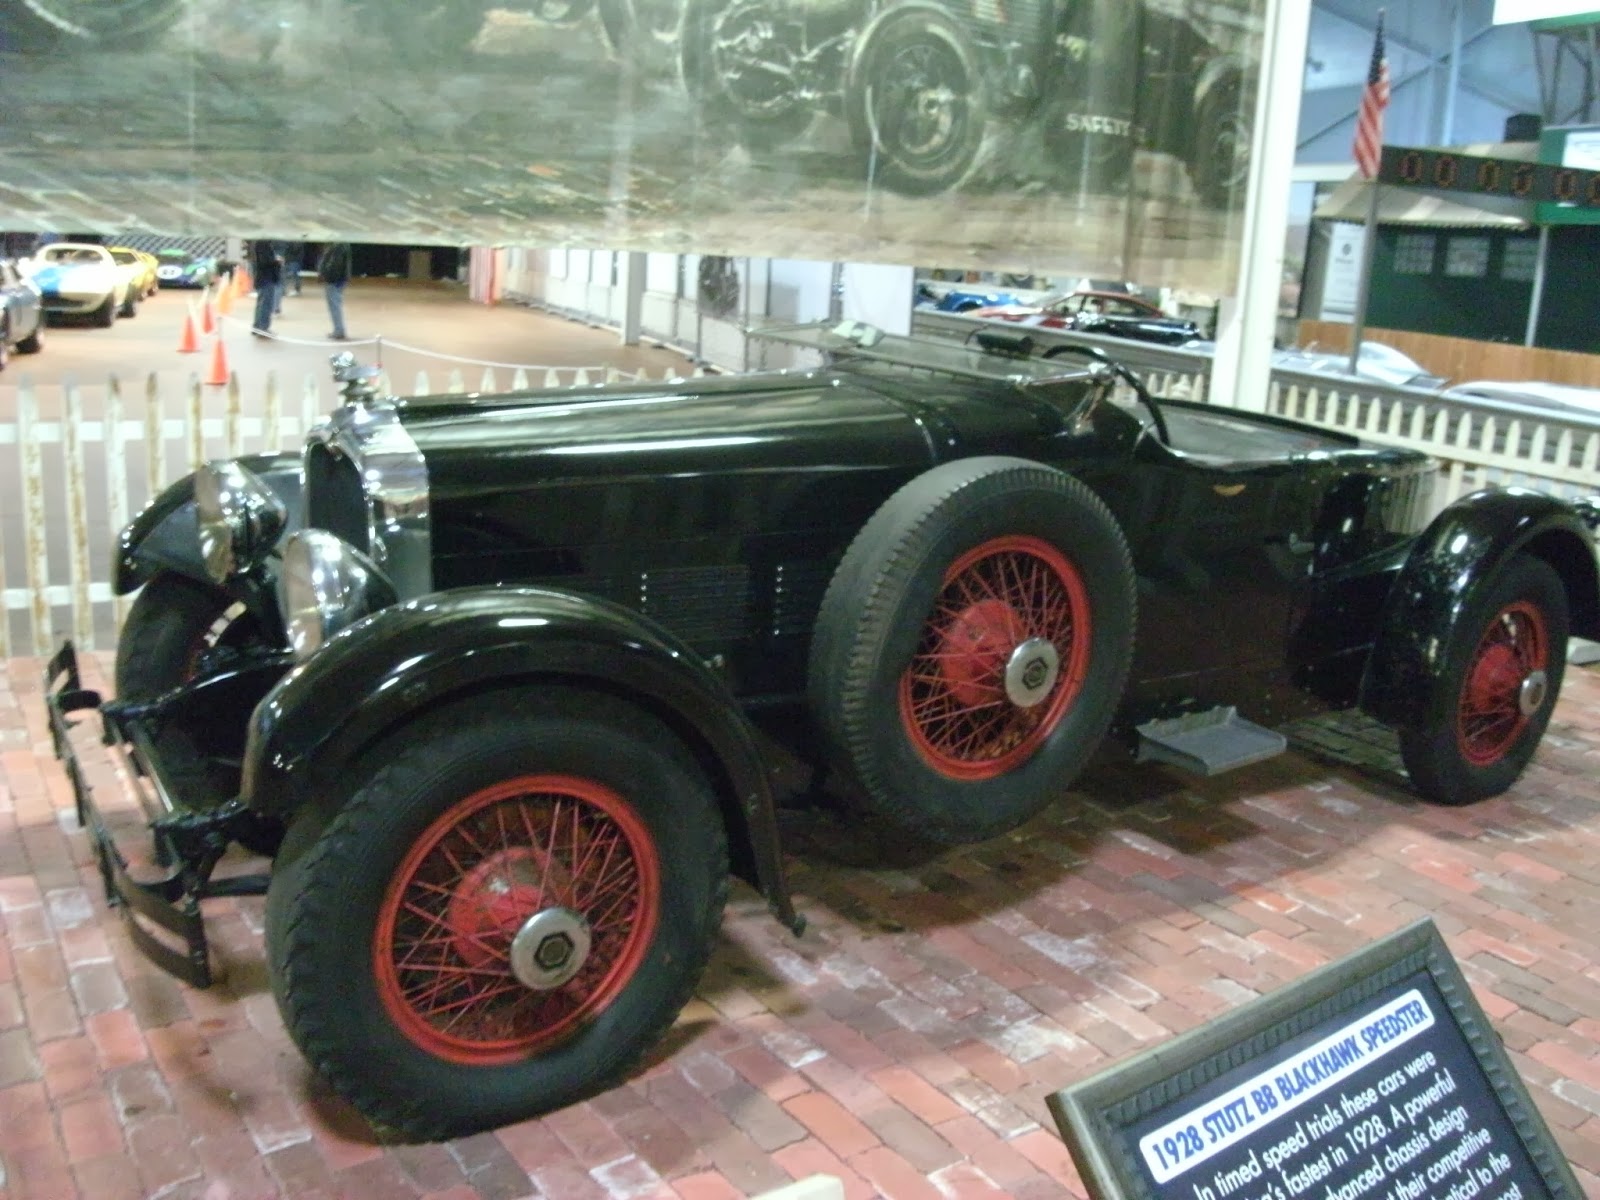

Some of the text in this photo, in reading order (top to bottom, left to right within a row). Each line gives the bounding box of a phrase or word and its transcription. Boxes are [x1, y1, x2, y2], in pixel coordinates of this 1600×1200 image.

[1152, 999, 1428, 1171] 1928 STUTZ BB BLACKHAWK SPEEDSTER
[1214, 1149, 1263, 1198] timed
[1262, 1121, 1309, 1172] speed
[1305, 1103, 1344, 1141] trials
[1340, 1093, 1379, 1119] these
[1378, 1069, 1407, 1097] cars
[1403, 1051, 1437, 1079] were
[1281, 1152, 1333, 1197] fastest
[1328, 1145, 1349, 1167] in
[1345, 1114, 1392, 1155] 1928.
[1389, 1104, 1407, 1129] A
[1403, 1067, 1457, 1126] powerful
[1324, 1153, 1386, 1200] dvanced
[1384, 1130, 1431, 1173] chassis
[1428, 1105, 1469, 1141] design
[1395, 1127, 1492, 1200] their competitive
[1475, 1168, 1493, 1187] to
[1488, 1151, 1512, 1176] the
